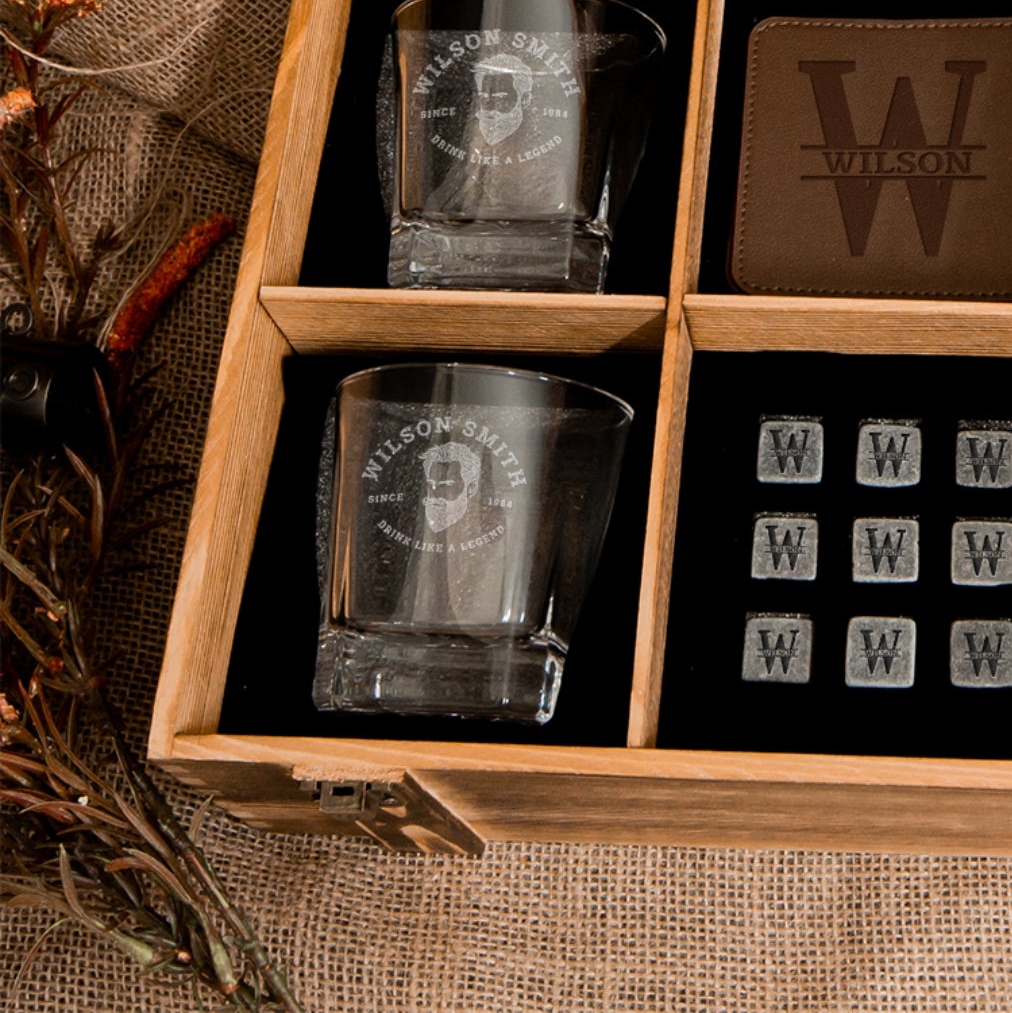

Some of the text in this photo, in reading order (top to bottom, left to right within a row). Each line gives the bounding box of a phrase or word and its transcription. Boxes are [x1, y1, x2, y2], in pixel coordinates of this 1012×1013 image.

[413, 29, 581, 98] WILSON SMITH
[420, 107, 457, 119] SINCE
[430, 134, 562, 166] DRINK LIKE A LEGEND
[798, 60, 987, 257] W
[822, 151, 973, 174] WILSON
[361, 416, 527, 488] WILSON SMITH
[769, 429, 810, 473] W
[869, 432, 910, 478] W
[966, 437, 1007, 483] W
[367, 492, 404, 504] SINCE
[376, 519, 506, 553] DRINK LIKE A LEGEND
[765, 525, 806, 571] W
[865, 528, 906, 574] W
[964, 531, 1005, 576] W
[758, 630, 799, 674] W
[860, 630, 902, 674] W
[964, 632, 1005, 678] W
